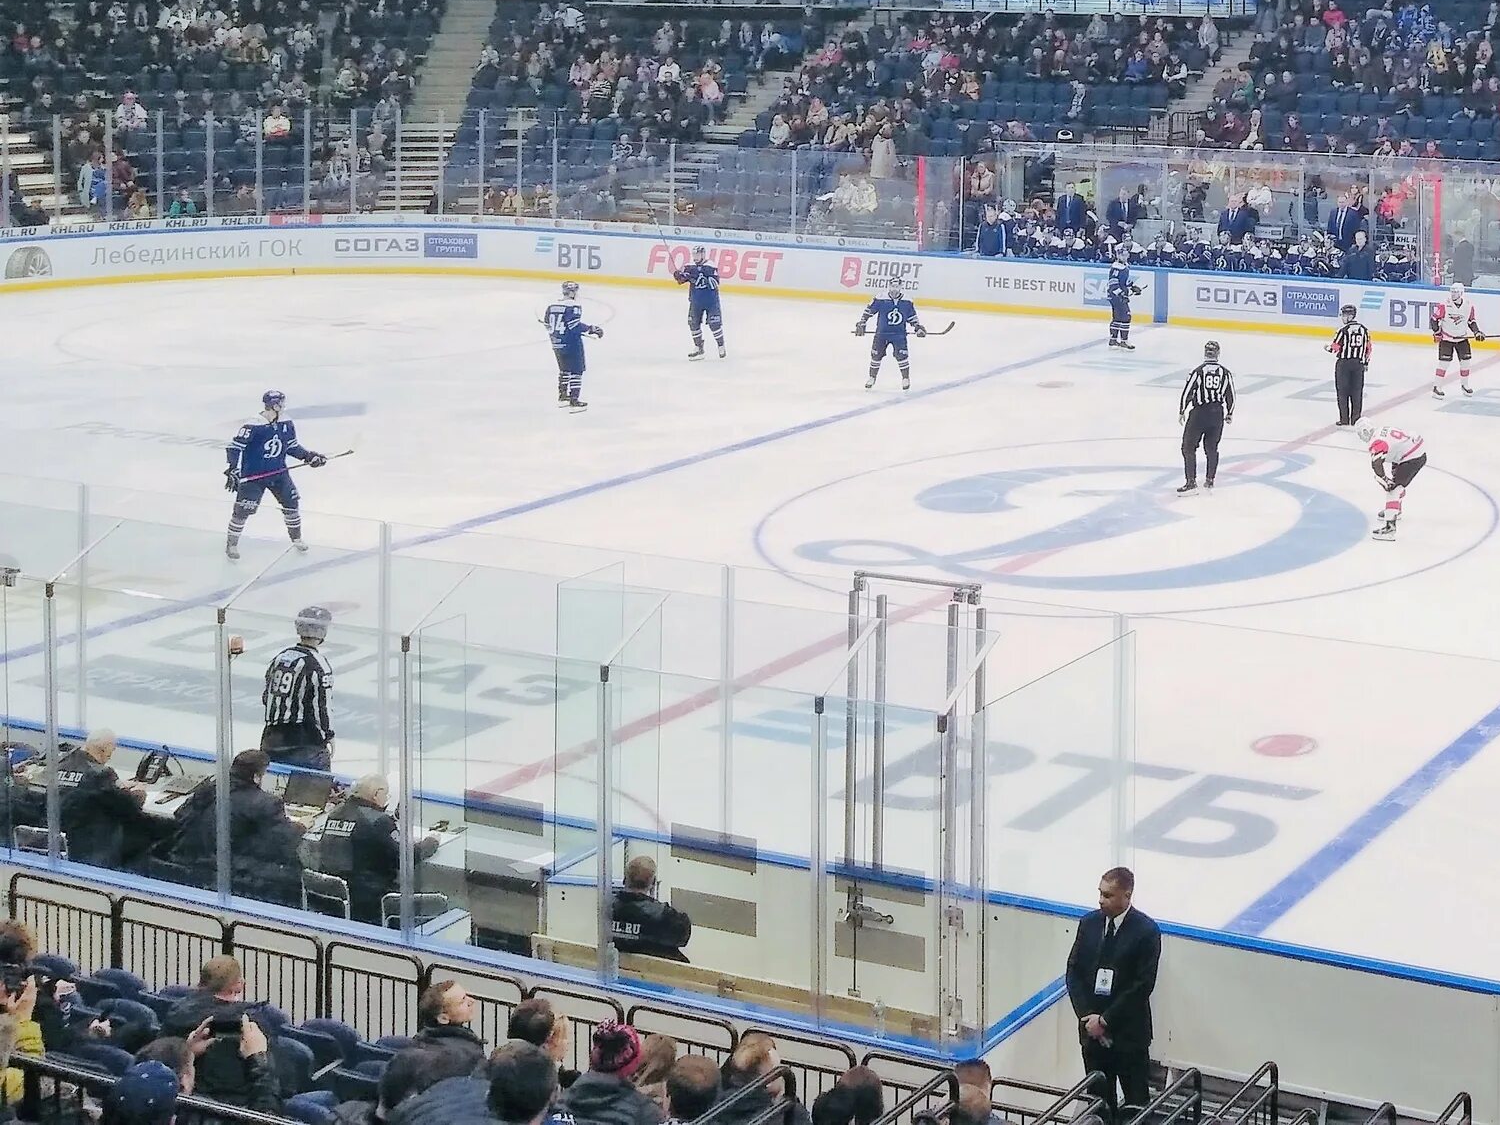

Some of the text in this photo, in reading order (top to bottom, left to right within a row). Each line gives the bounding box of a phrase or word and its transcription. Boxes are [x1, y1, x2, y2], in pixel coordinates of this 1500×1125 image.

[108, 221, 152, 231] KHL.RU
[165, 218, 208, 229] KHL.RU
[221, 216, 263, 226] KHL.RU
[50, 225, 95, 235] KHL.RU
[334, 236, 420, 253] СОГАЗ
[428, 236, 474, 247] СТРАХОВАЯ
[435, 244, 468, 254] ГРУППА
[91, 239, 304, 267] Лебединский ГОК
[557, 242, 602, 270] ВТБ
[647, 244, 784, 283] FOBET
[866, 259, 923, 279] СПОРТ
[984, 276, 1076, 294] THE BEST RUN
[1196, 286, 1277, 307] СОГАЗ
[1286, 291, 1336, 304] СТРАХОВАЯ
[1294, 300, 1328, 311] ГРУППА
[1204, 375, 1219, 389] 89
[271, 669, 294, 693] 99
[832, 735, 1323, 859] ВТБ
